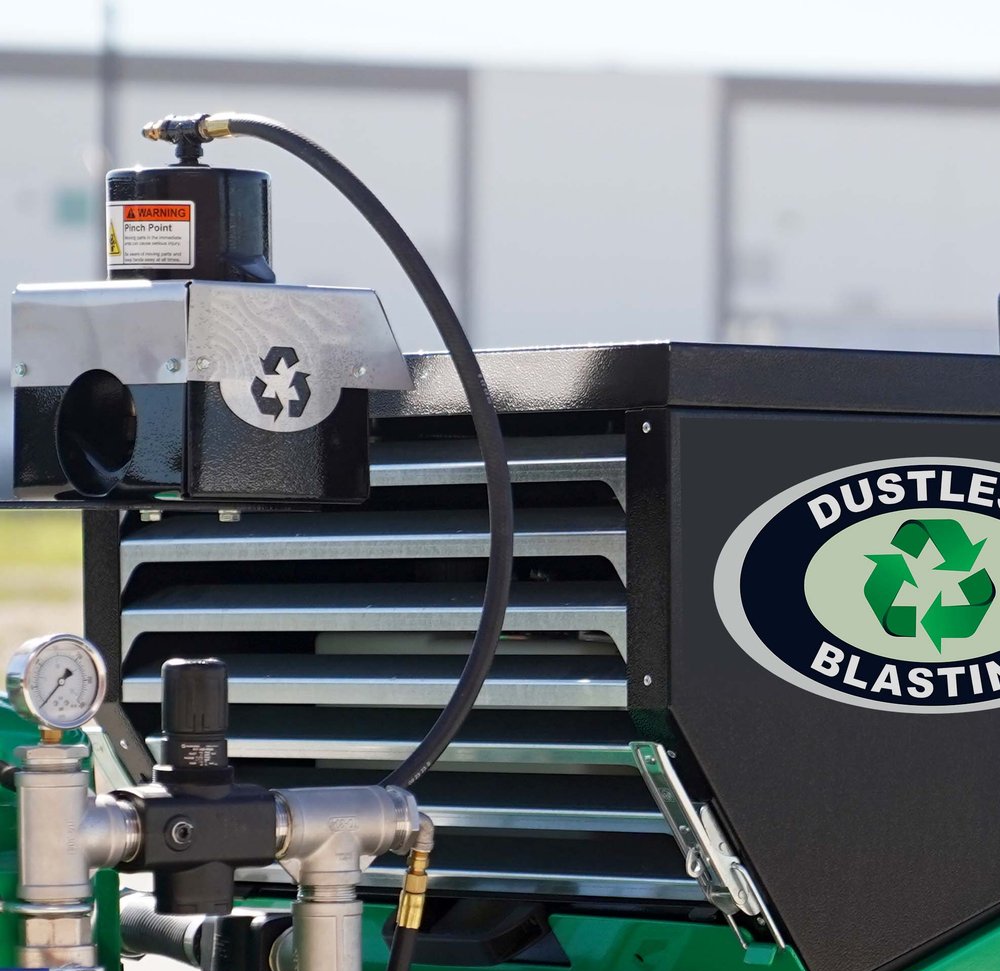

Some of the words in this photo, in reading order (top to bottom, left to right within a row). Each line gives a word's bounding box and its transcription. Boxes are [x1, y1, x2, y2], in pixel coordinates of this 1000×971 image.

[138, 208, 186, 217] WARNING
[124, 224, 146, 232] Pinch
[148, 224, 172, 232] Point
